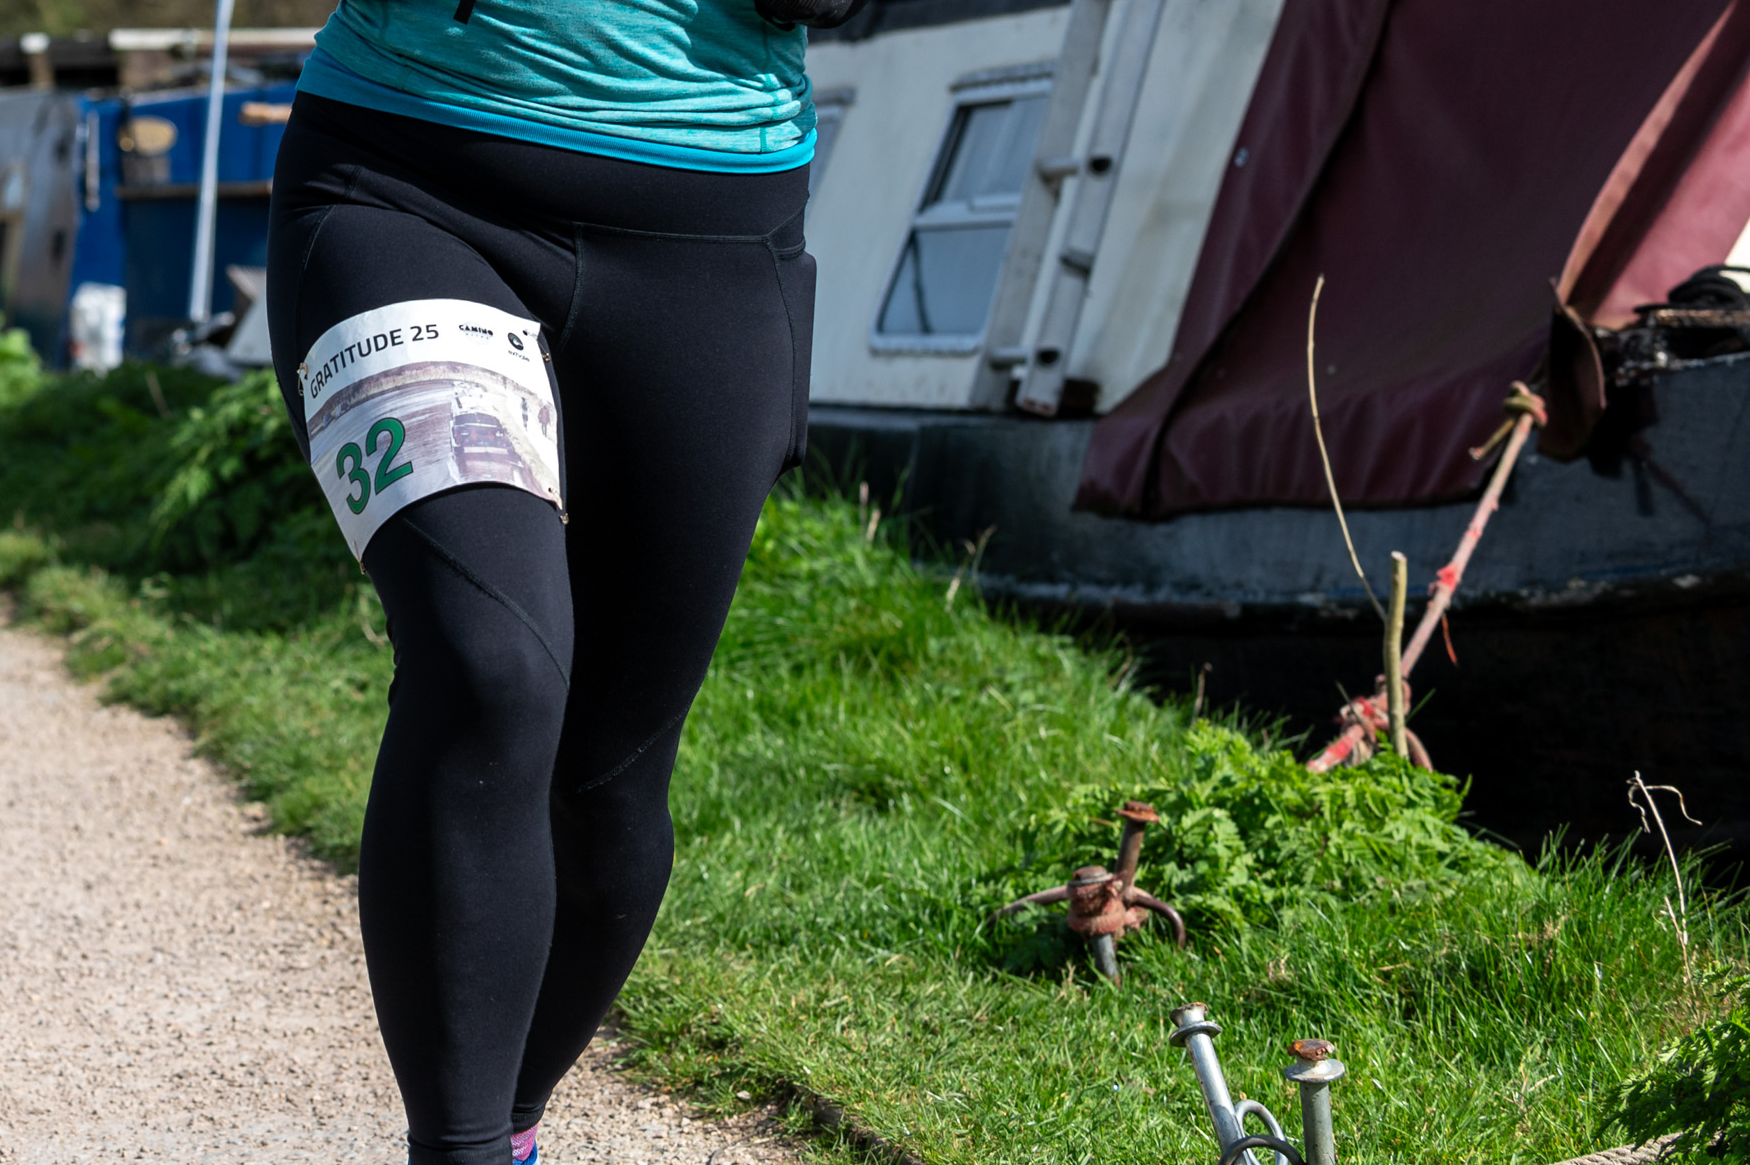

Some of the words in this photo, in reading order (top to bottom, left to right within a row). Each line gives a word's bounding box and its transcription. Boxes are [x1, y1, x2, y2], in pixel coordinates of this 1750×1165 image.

[310, 328, 404, 399] GRATITUDE
[409, 323, 440, 342] 25
[458, 324, 494, 337] CAMINO
[336, 416, 414, 515] 32
